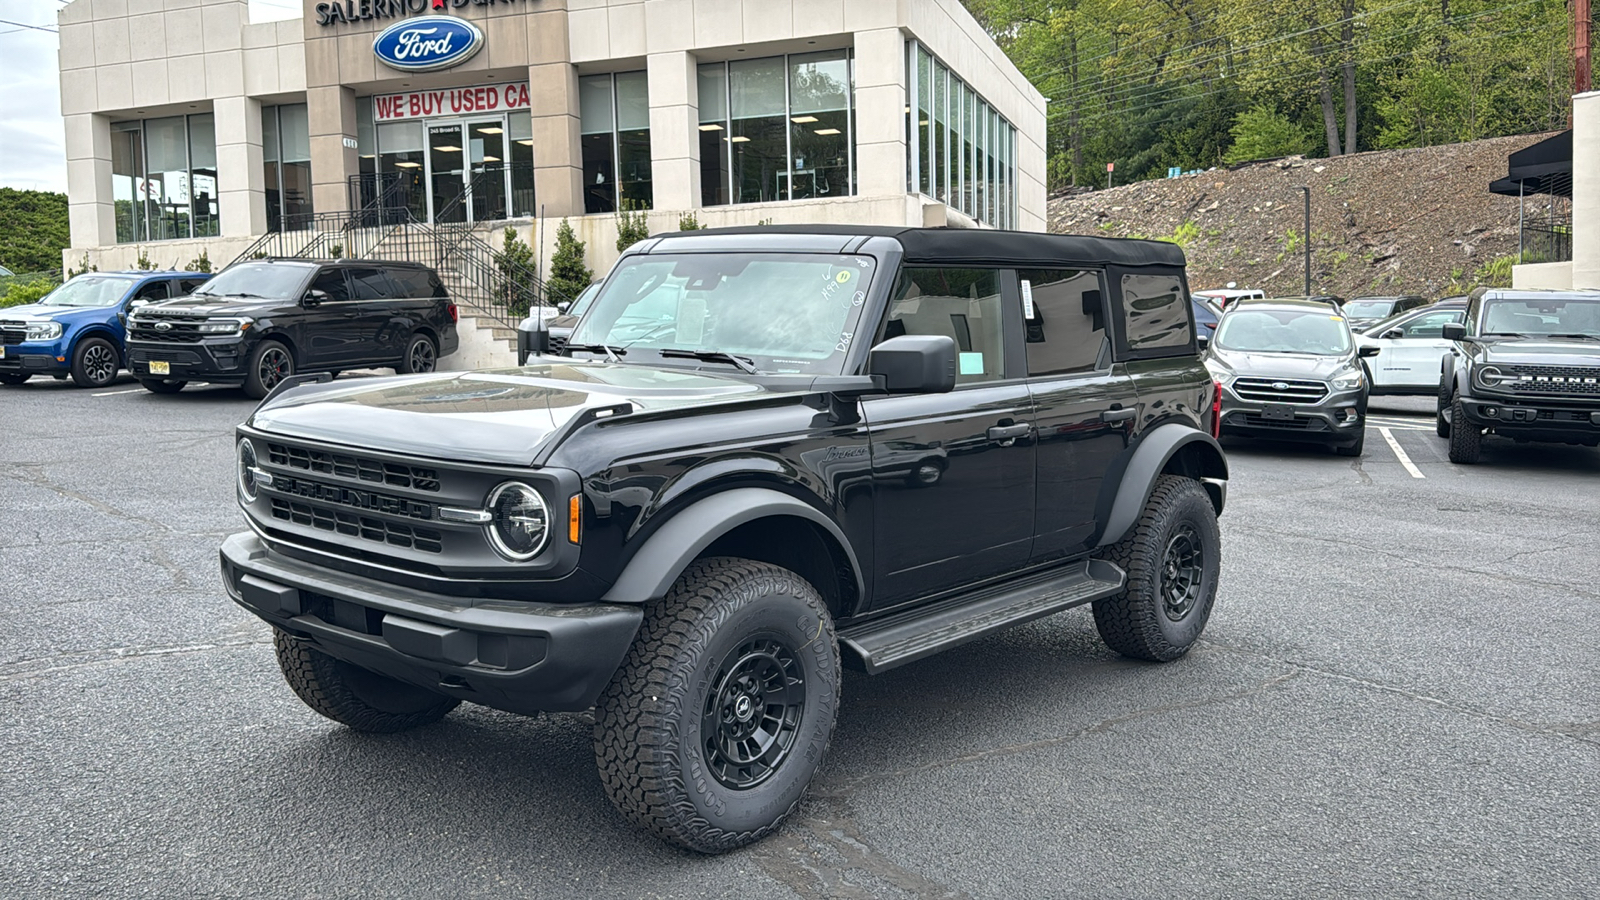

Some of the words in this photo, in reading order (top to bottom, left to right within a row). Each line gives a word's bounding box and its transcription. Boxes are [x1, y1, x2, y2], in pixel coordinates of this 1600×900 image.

[315, 0, 428, 26] SALERNO
[394, 27, 453, 59] Ford
[376, 95, 404, 118] WE
[409, 92, 444, 116] BUY
[451, 87, 499, 113] USED
[504, 84, 530, 108] CA
